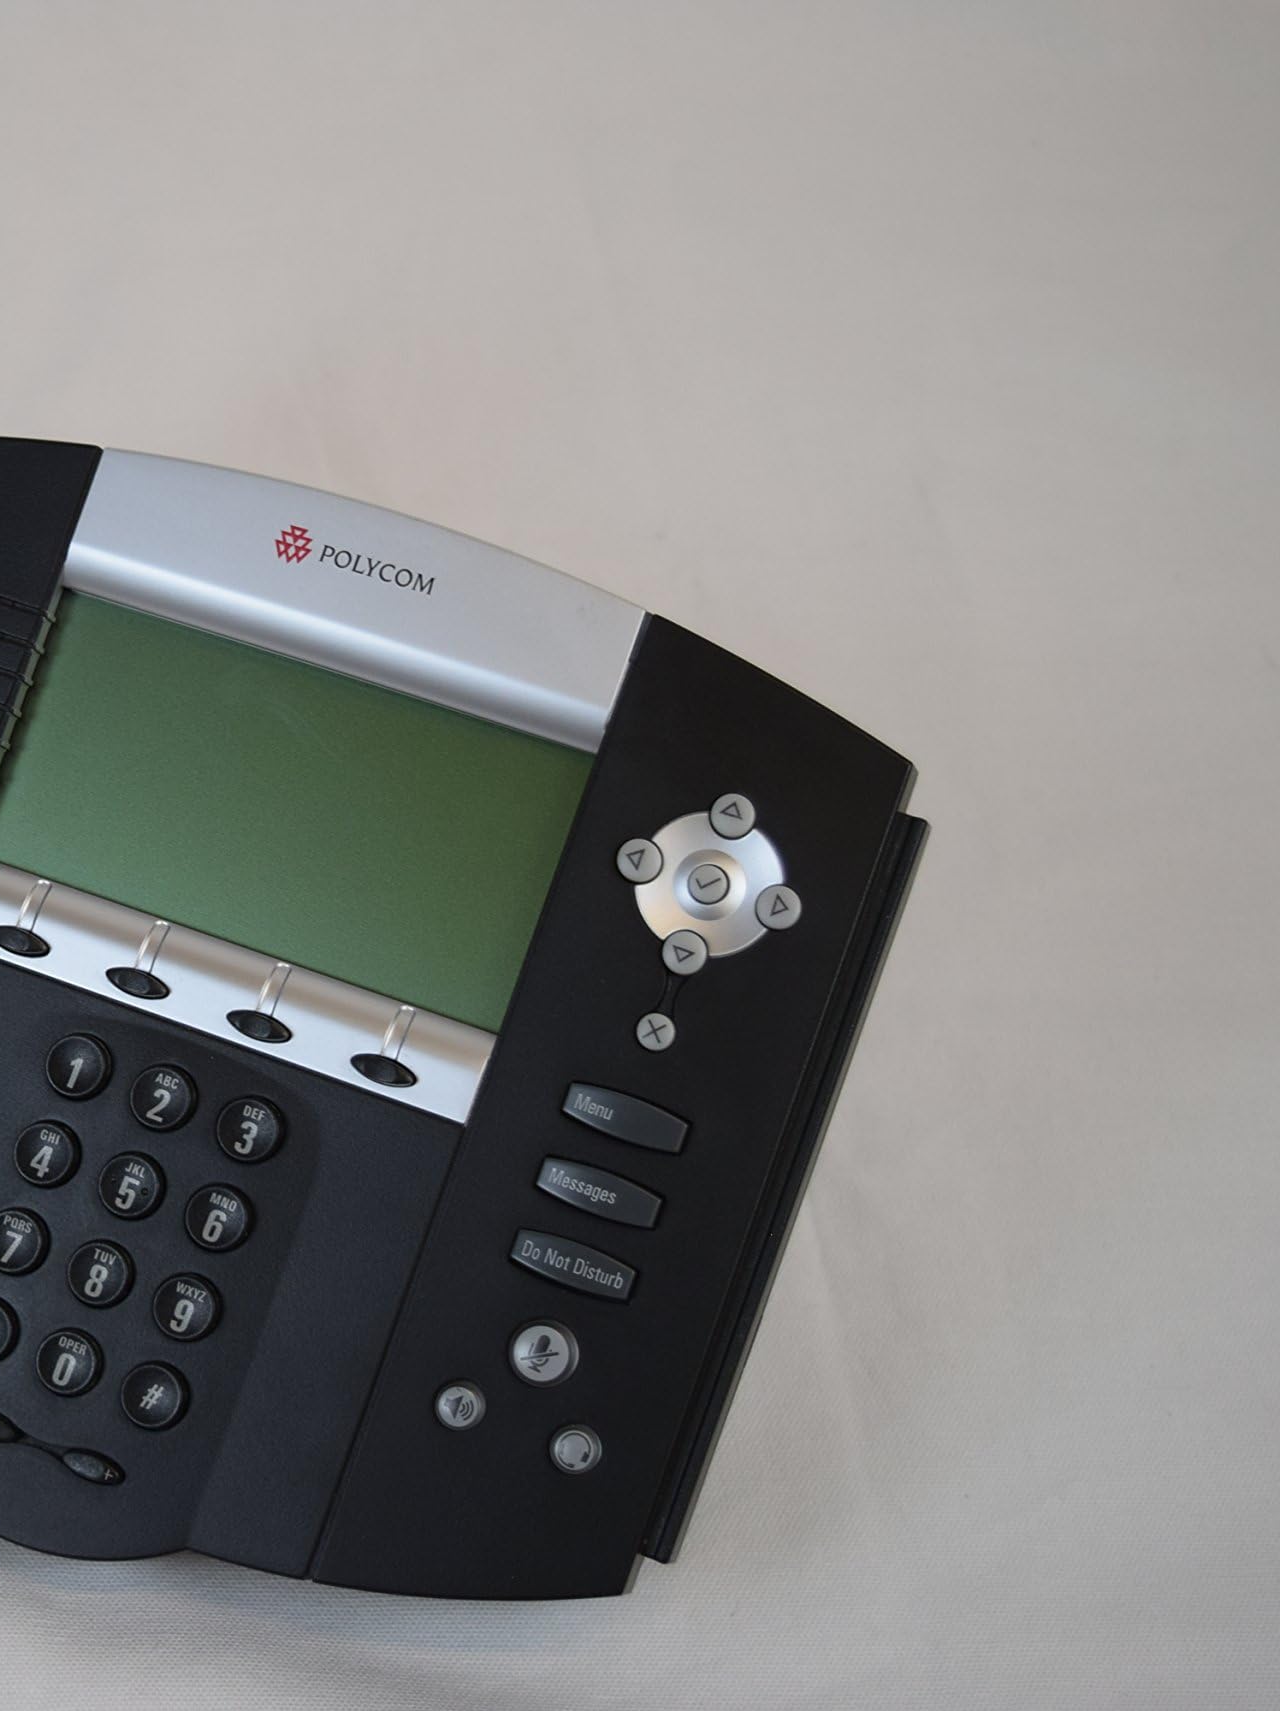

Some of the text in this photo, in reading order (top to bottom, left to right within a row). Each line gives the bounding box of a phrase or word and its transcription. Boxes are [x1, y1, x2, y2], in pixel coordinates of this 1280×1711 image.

[318, 544, 436, 596] POLYCOM
[66, 1057, 83, 1089] 1
[154, 1072, 180, 1090] ABC
[145, 1088, 172, 1123] 2
[242, 1104, 266, 1122] DEF
[573, 1093, 614, 1121] Menu
[39, 1128, 61, 1146] GHI
[233, 1121, 259, 1155] 3
[30, 1145, 54, 1178] 4
[124, 1161, 146, 1179] JKL
[114, 1175, 141, 1210] 5
[208, 1192, 238, 1213] MNO
[547, 1167, 617, 1205] Messages
[2, 1214, 34, 1235] PQRS
[201, 1208, 228, 1244] 6
[0, 1229, 24, 1264] 7
[93, 1247, 118, 1266] TUV
[83, 1263, 109, 1299] 8
[521, 1240, 625, 1290] Do Not Disturb
[175, 1281, 208, 1303] WXYZ
[169, 1298, 195, 1334] 9
[58, 1335, 88, 1357] OPER
[51, 1352, 76, 1387] 0
